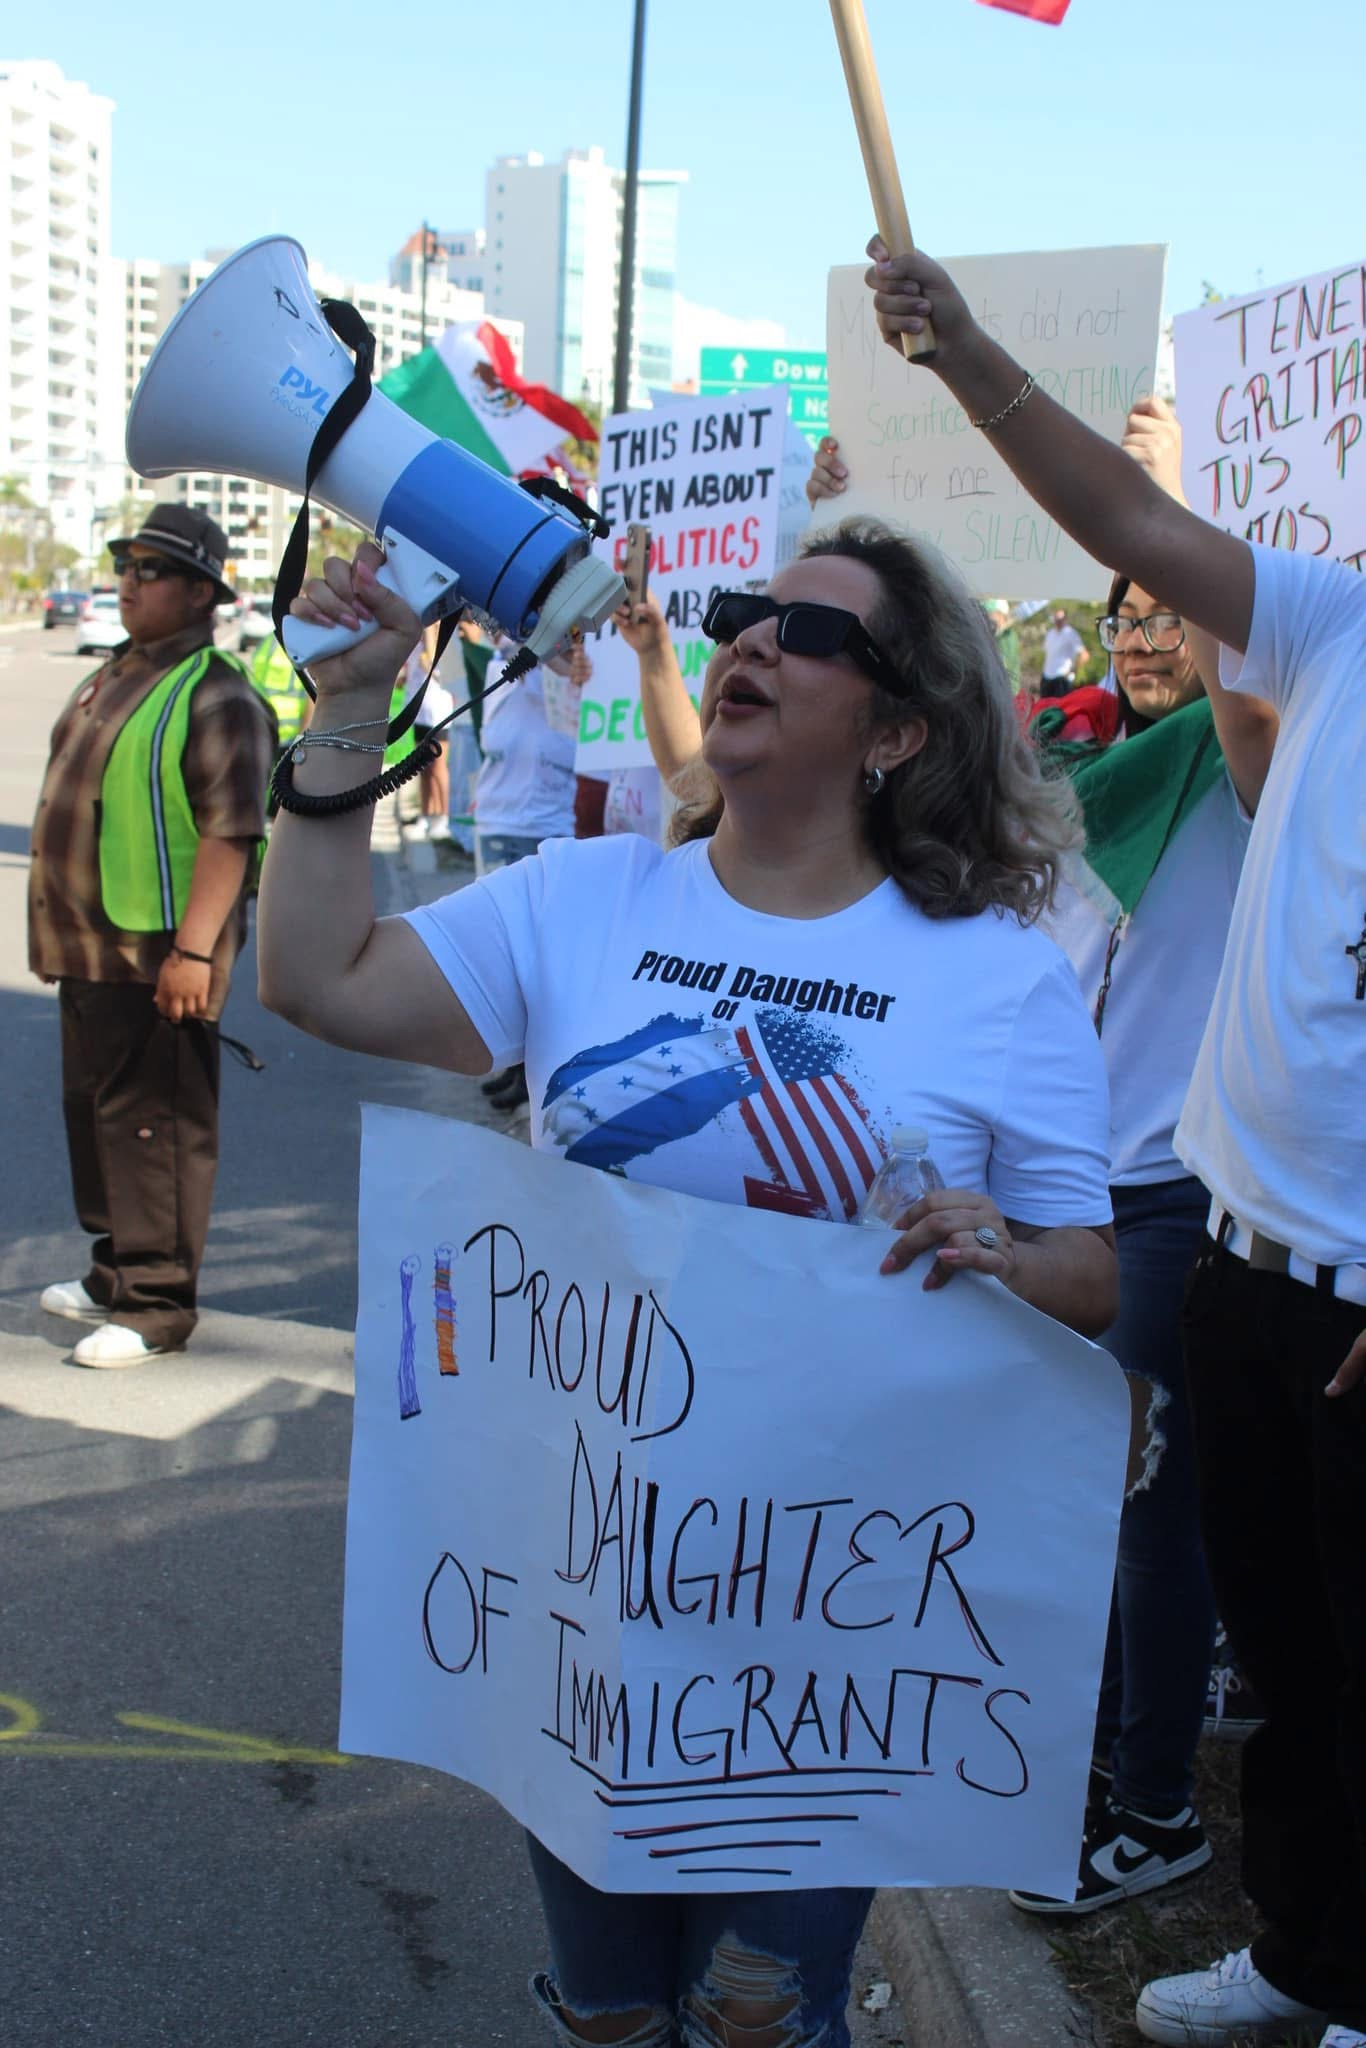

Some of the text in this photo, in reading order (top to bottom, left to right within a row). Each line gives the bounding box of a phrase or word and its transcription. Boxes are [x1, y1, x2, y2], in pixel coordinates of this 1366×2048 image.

[1019, 289, 1062, 342] did
[1076, 289, 1127, 337] not
[1213, 265, 1366, 368] TENE
[278, 365, 331, 417] PYL
[772, 358, 828, 381] Dow
[1215, 337, 1366, 445] GRITA
[607, 403, 772, 473] THIS ISN'T
[600, 475, 675, 528] EVEN
[683, 467, 774, 509] ABOUT
[887, 454, 989, 503] for me
[1199, 446, 1291, 517] TUS
[632, 950, 896, 1023] Proud Daughter
[463, 1223, 695, 1442] PROUD
[555, 1419, 1005, 1667] DAUGHTER
[422, 1551, 518, 1674] OF
[542, 1611, 1031, 1797] IMMIGRANTS
